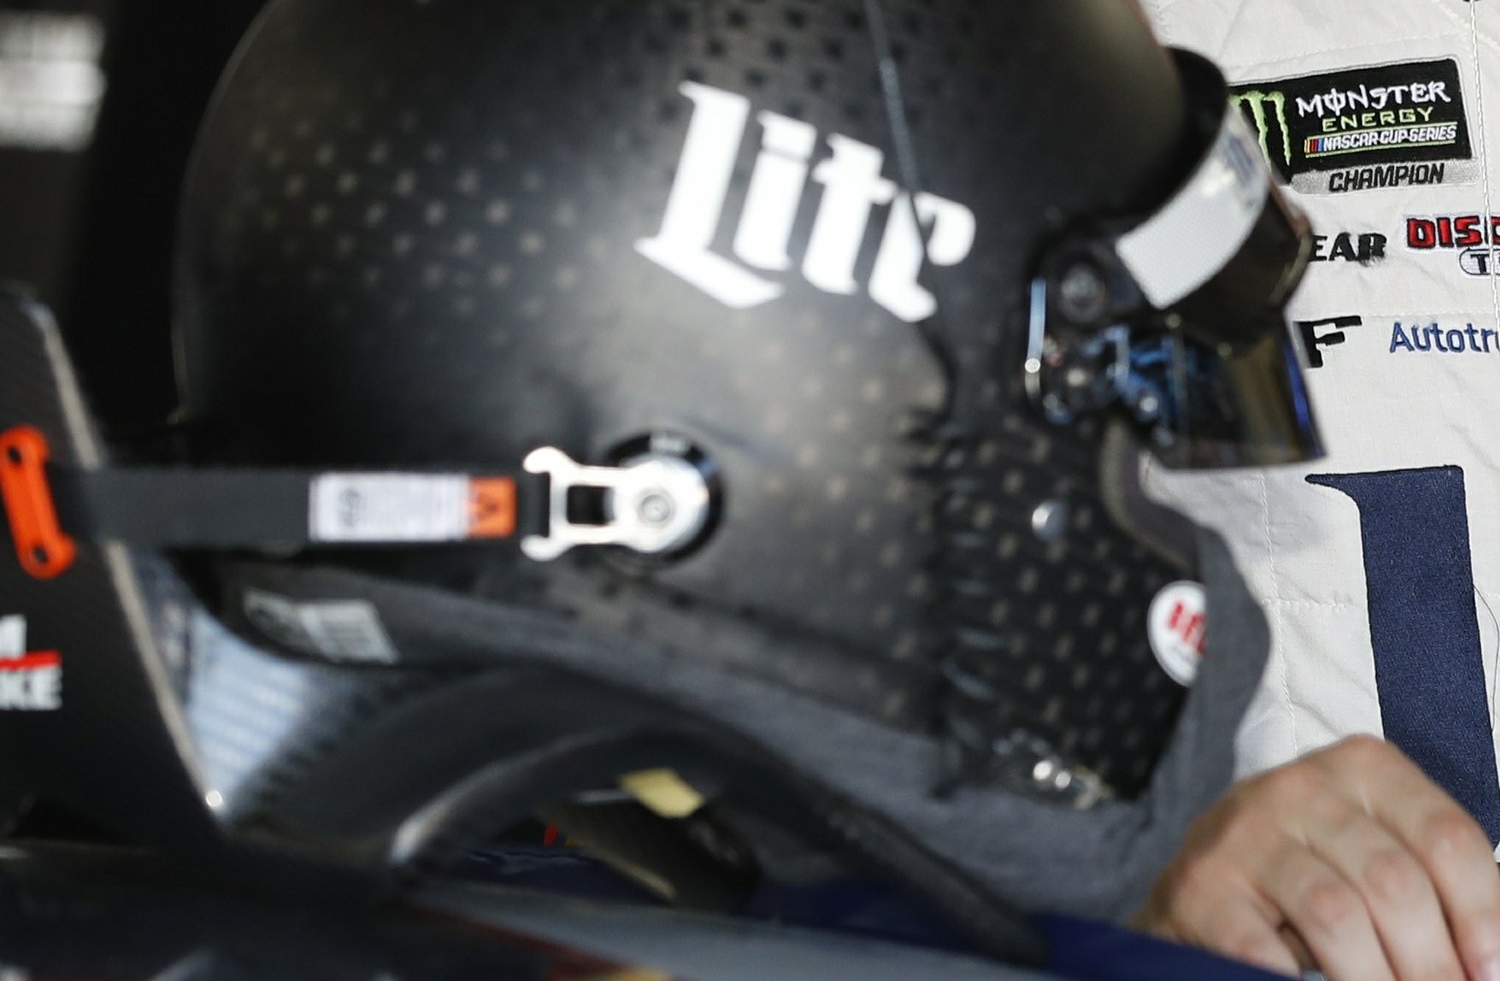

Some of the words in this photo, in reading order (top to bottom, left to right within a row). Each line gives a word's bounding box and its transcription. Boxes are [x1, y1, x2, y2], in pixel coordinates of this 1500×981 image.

[1322, 106, 1434, 132] ENERGY
[1329, 163, 1445, 193] CHAMPION
[634, 80, 977, 322] Lite
